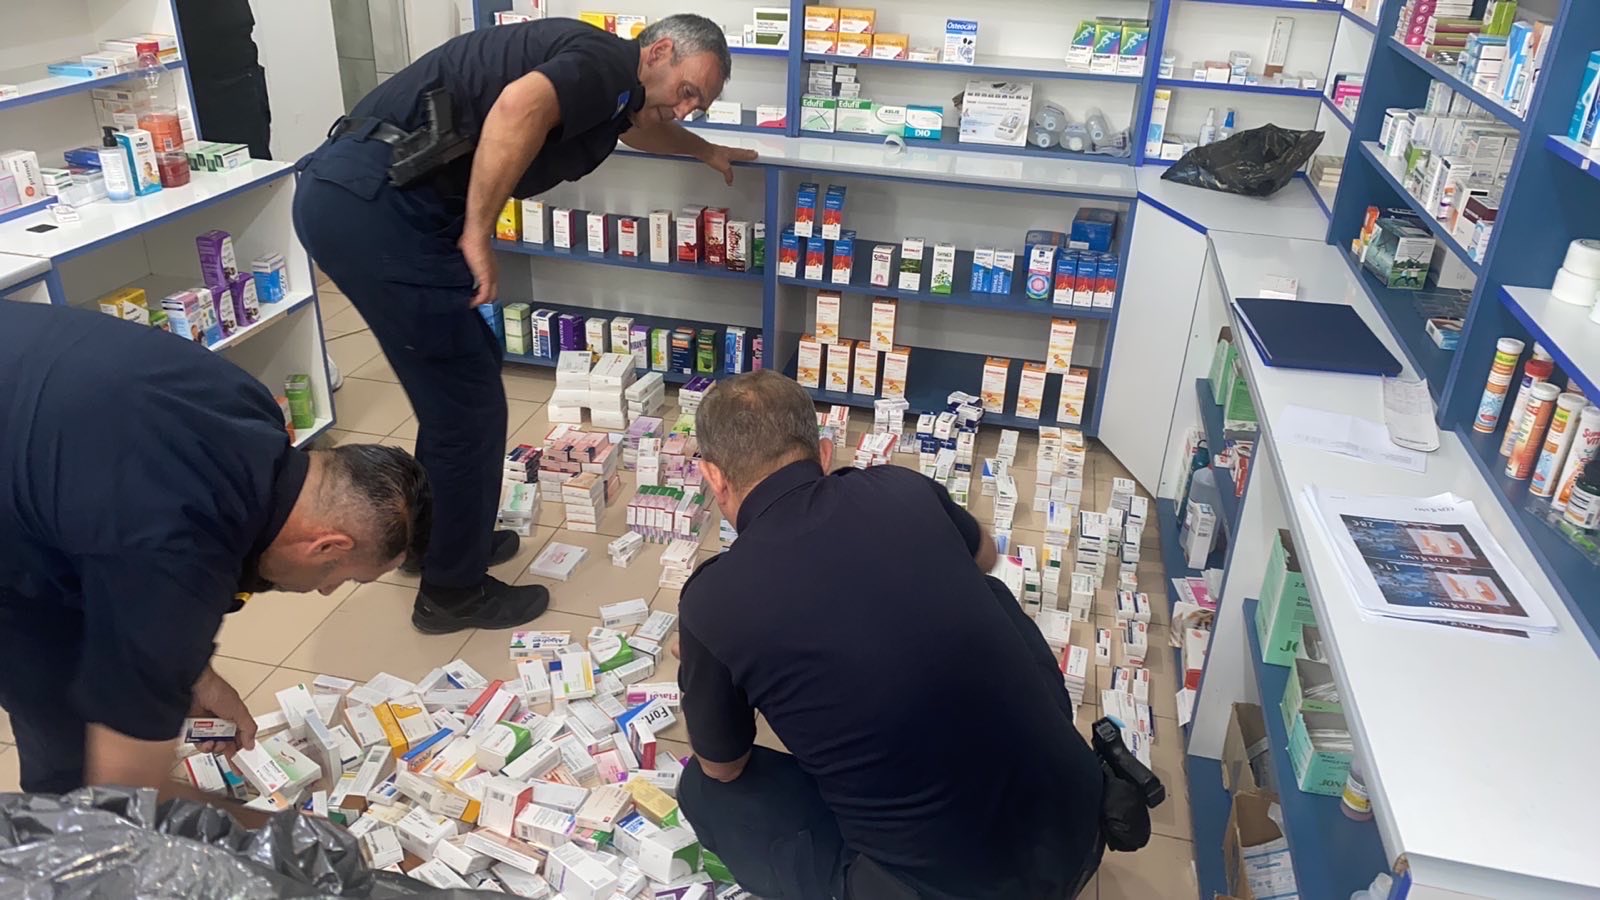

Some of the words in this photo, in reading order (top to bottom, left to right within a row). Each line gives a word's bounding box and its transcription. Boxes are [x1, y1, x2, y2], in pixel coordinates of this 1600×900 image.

[947, 21, 977, 30] Osteocare
[803, 100, 824, 108] Edufil
[838, 100, 860, 108] Edufil
[914, 129, 931, 137] DIO
